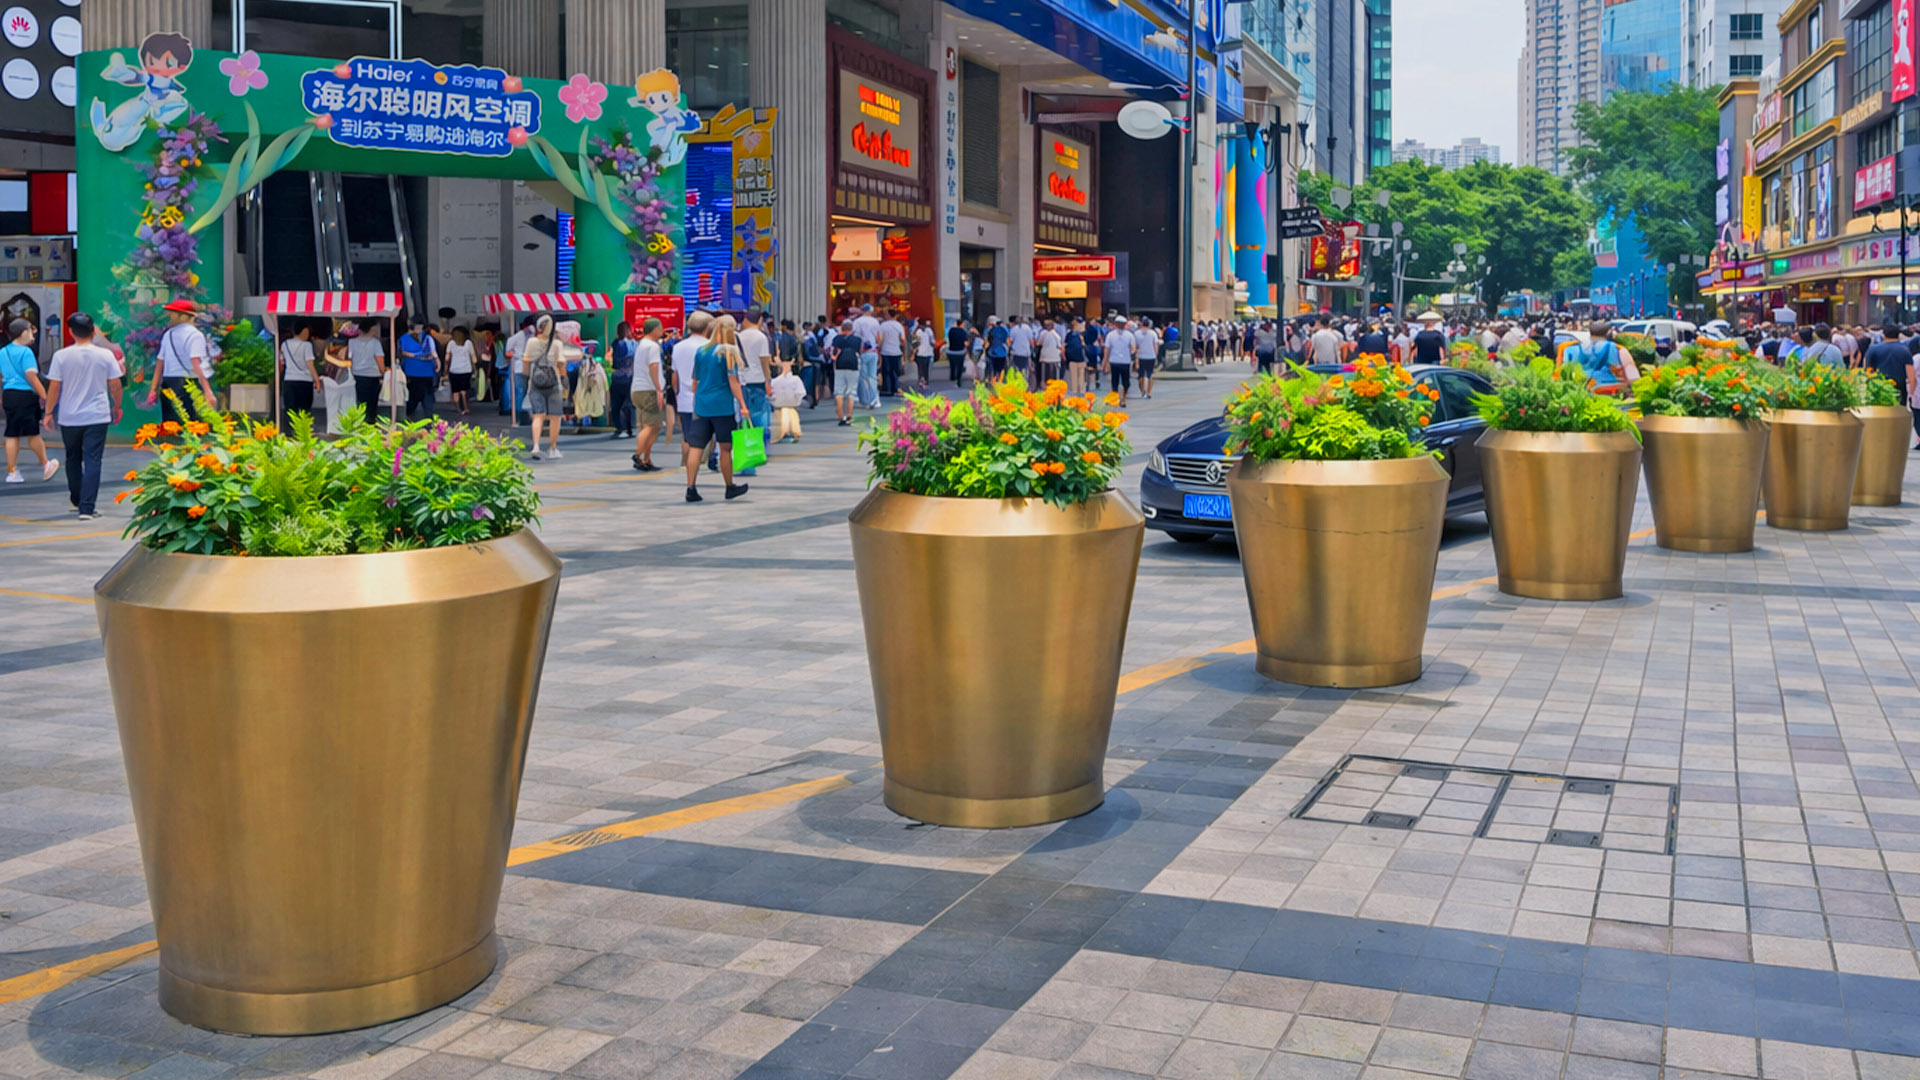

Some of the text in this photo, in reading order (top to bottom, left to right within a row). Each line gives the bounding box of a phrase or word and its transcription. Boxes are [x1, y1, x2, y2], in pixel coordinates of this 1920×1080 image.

[356, 63, 413, 83] Haier
[312, 79, 532, 127] 海尔聪明风空调
